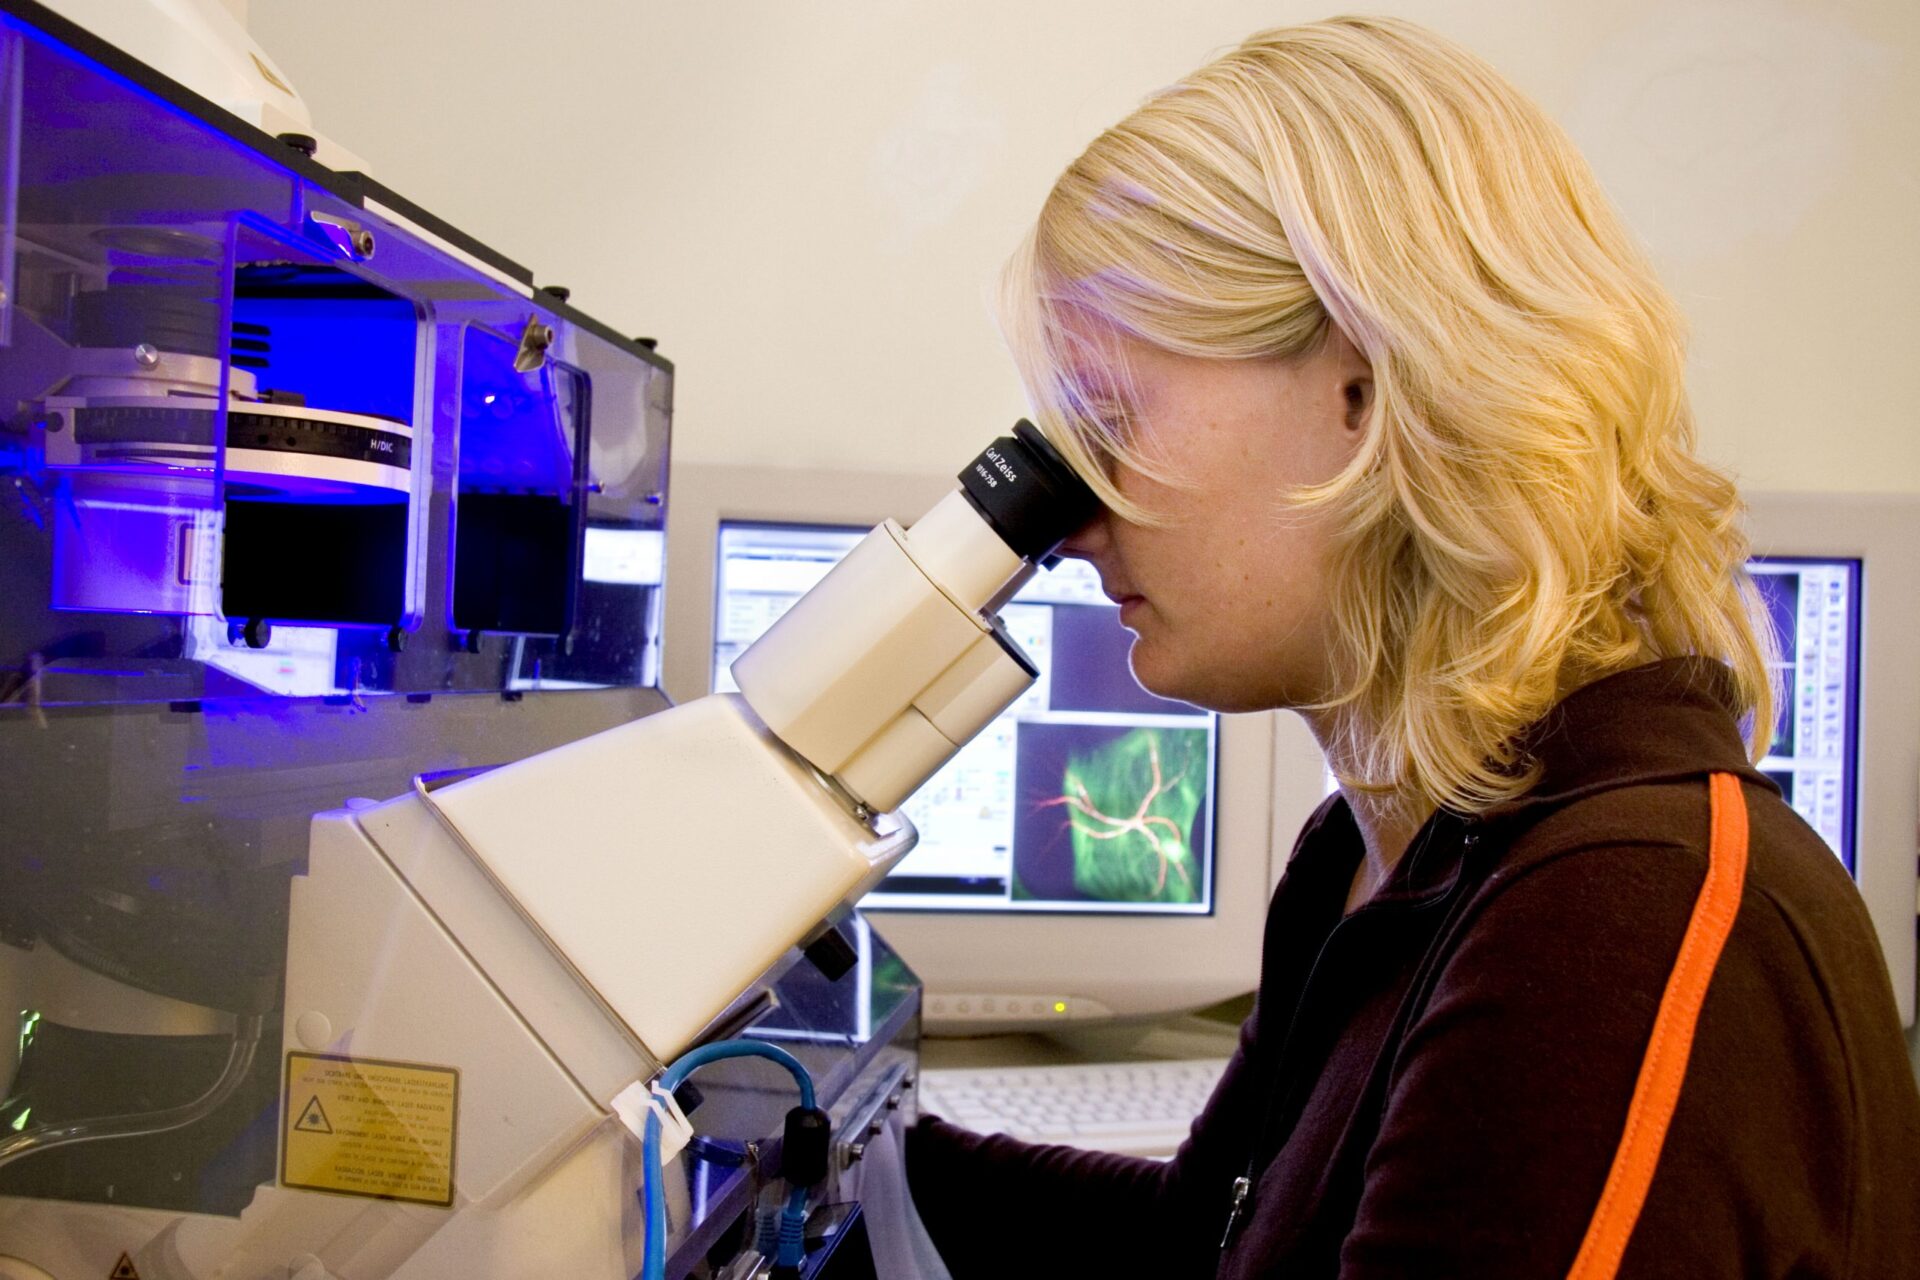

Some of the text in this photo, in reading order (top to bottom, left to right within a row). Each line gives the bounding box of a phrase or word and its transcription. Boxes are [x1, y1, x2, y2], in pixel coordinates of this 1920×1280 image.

[370, 439, 393, 453] H/DIC
[986, 447, 1017, 482] Carl Zeiss
